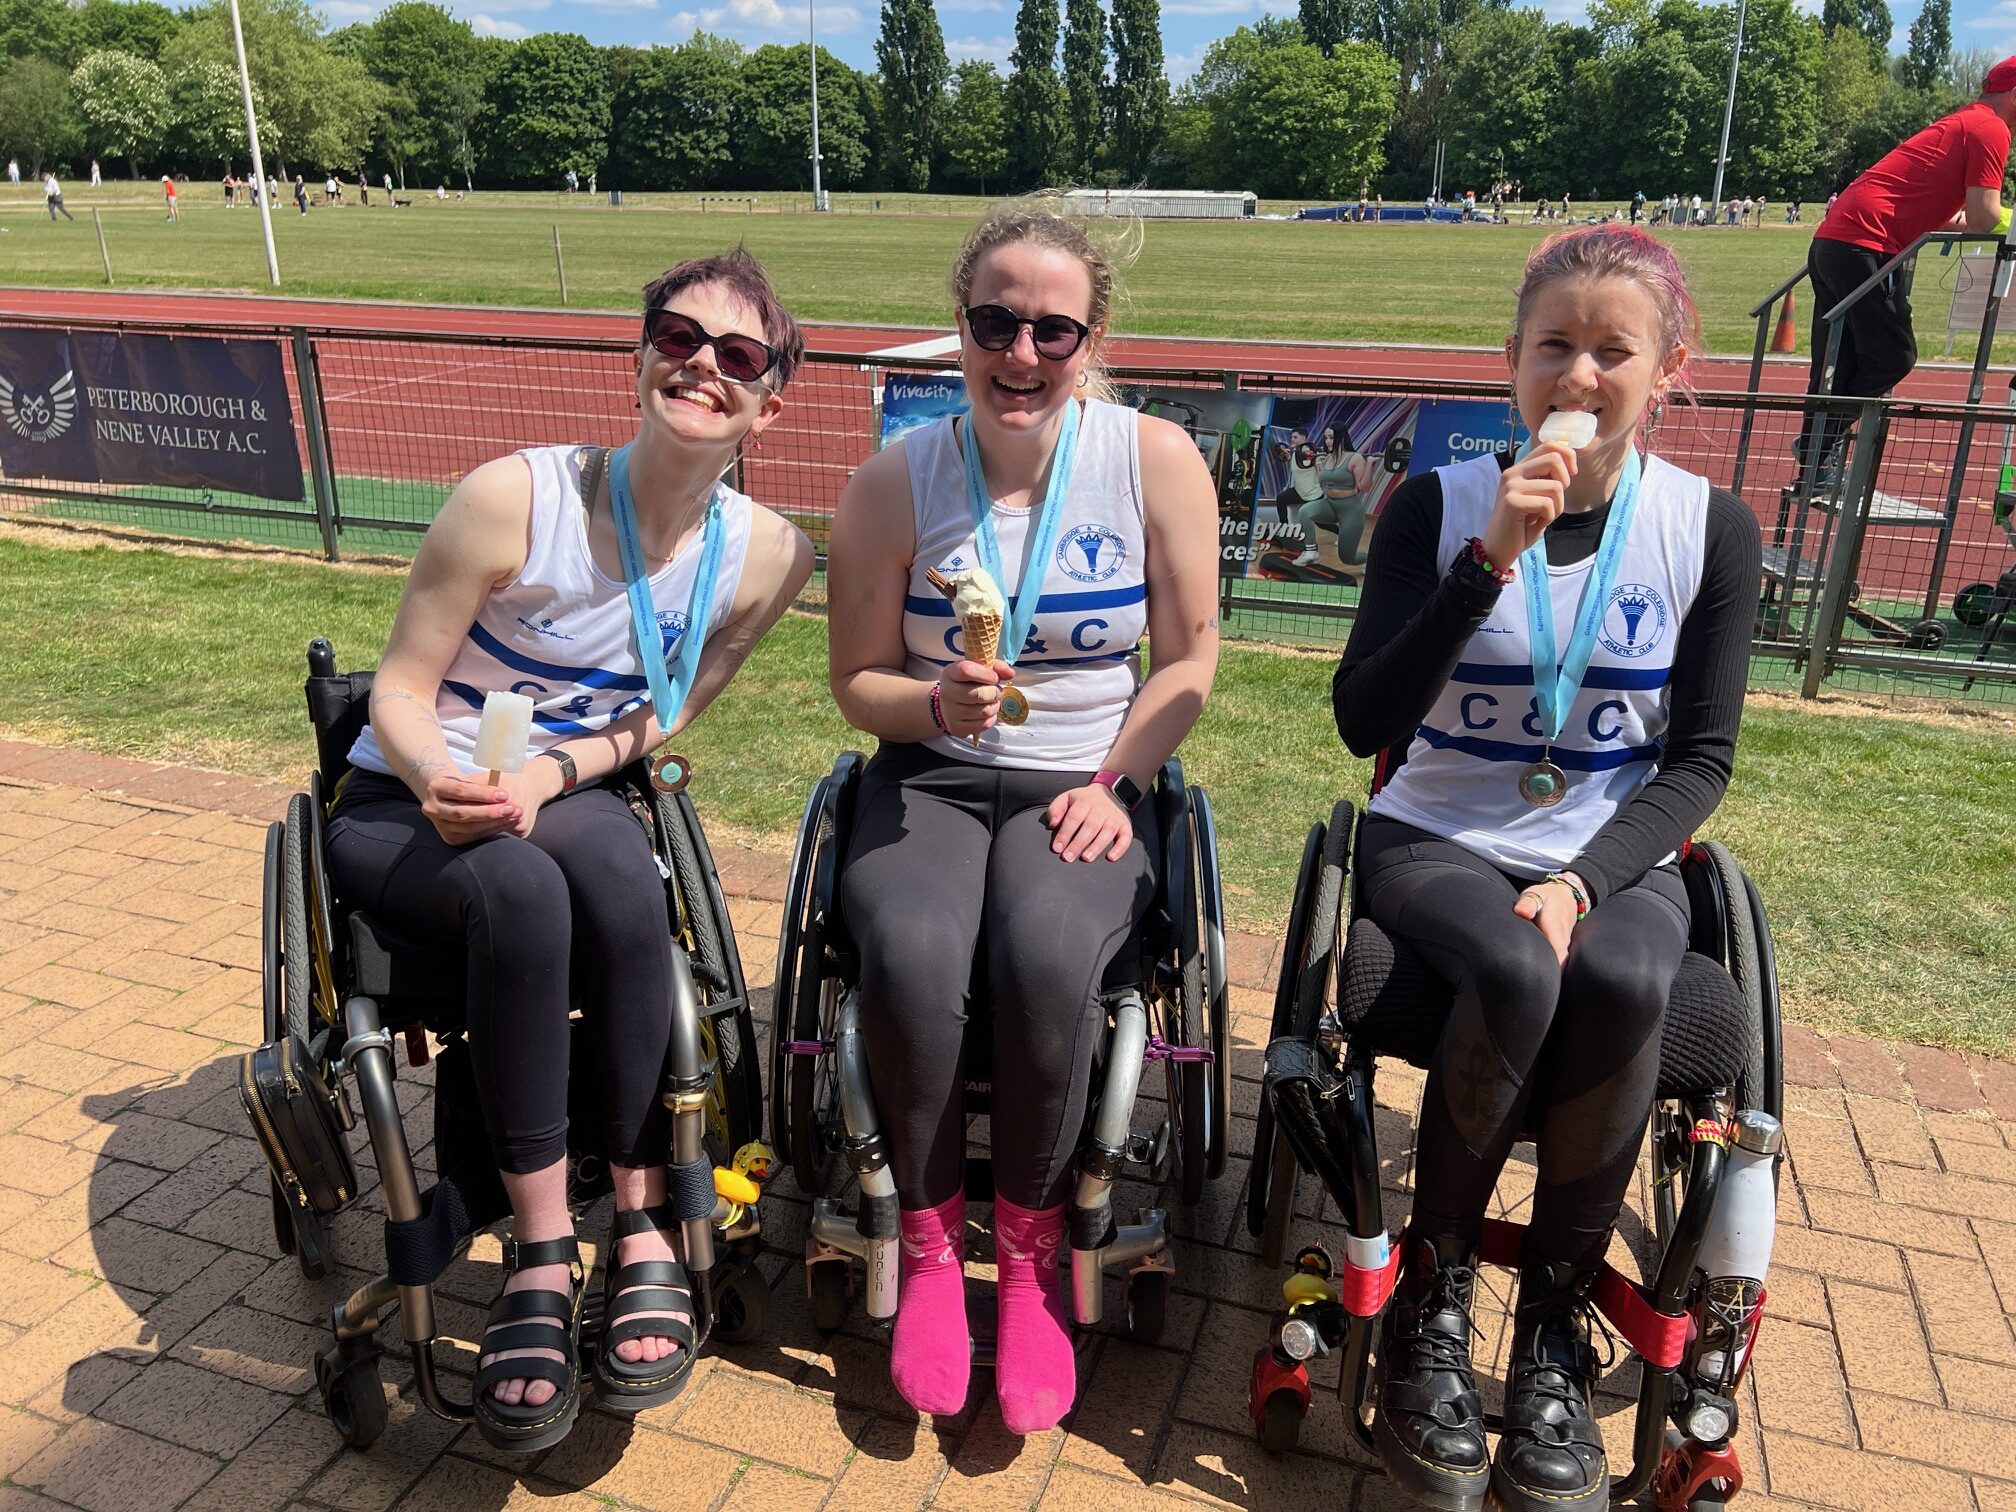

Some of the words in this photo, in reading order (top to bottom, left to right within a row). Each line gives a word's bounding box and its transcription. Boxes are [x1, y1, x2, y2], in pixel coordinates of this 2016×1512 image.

[86, 386, 246, 420] PETERBOROUGH
[251, 400, 268, 421] &
[892, 383, 954, 403] Vivacity
[96, 419, 145, 445] NENE
[147, 425, 222, 451] VALLEY
[226, 432, 267, 455] A.C.
[1447, 432, 1508, 454] Come
[1252, 522, 1306, 541] gym,
[1058, 528, 1081, 560] CAMBRIDGE
[1219, 543, 1271, 561] ces”
[1068, 570, 1098, 582] ATHLETIC
[1102, 567, 1117, 578] CLUB
[1645, 589, 1665, 628] COLERIDGE
[517, 616, 574, 641] RONHILL
[1070, 618, 1110, 651] C
[1603, 639, 1633, 656] ATHLETIC
[1639, 642, 1655, 655] CLUB
[558, 695, 594, 718] &
[1460, 692, 1499, 730] C
[1587, 700, 1628, 742] C
